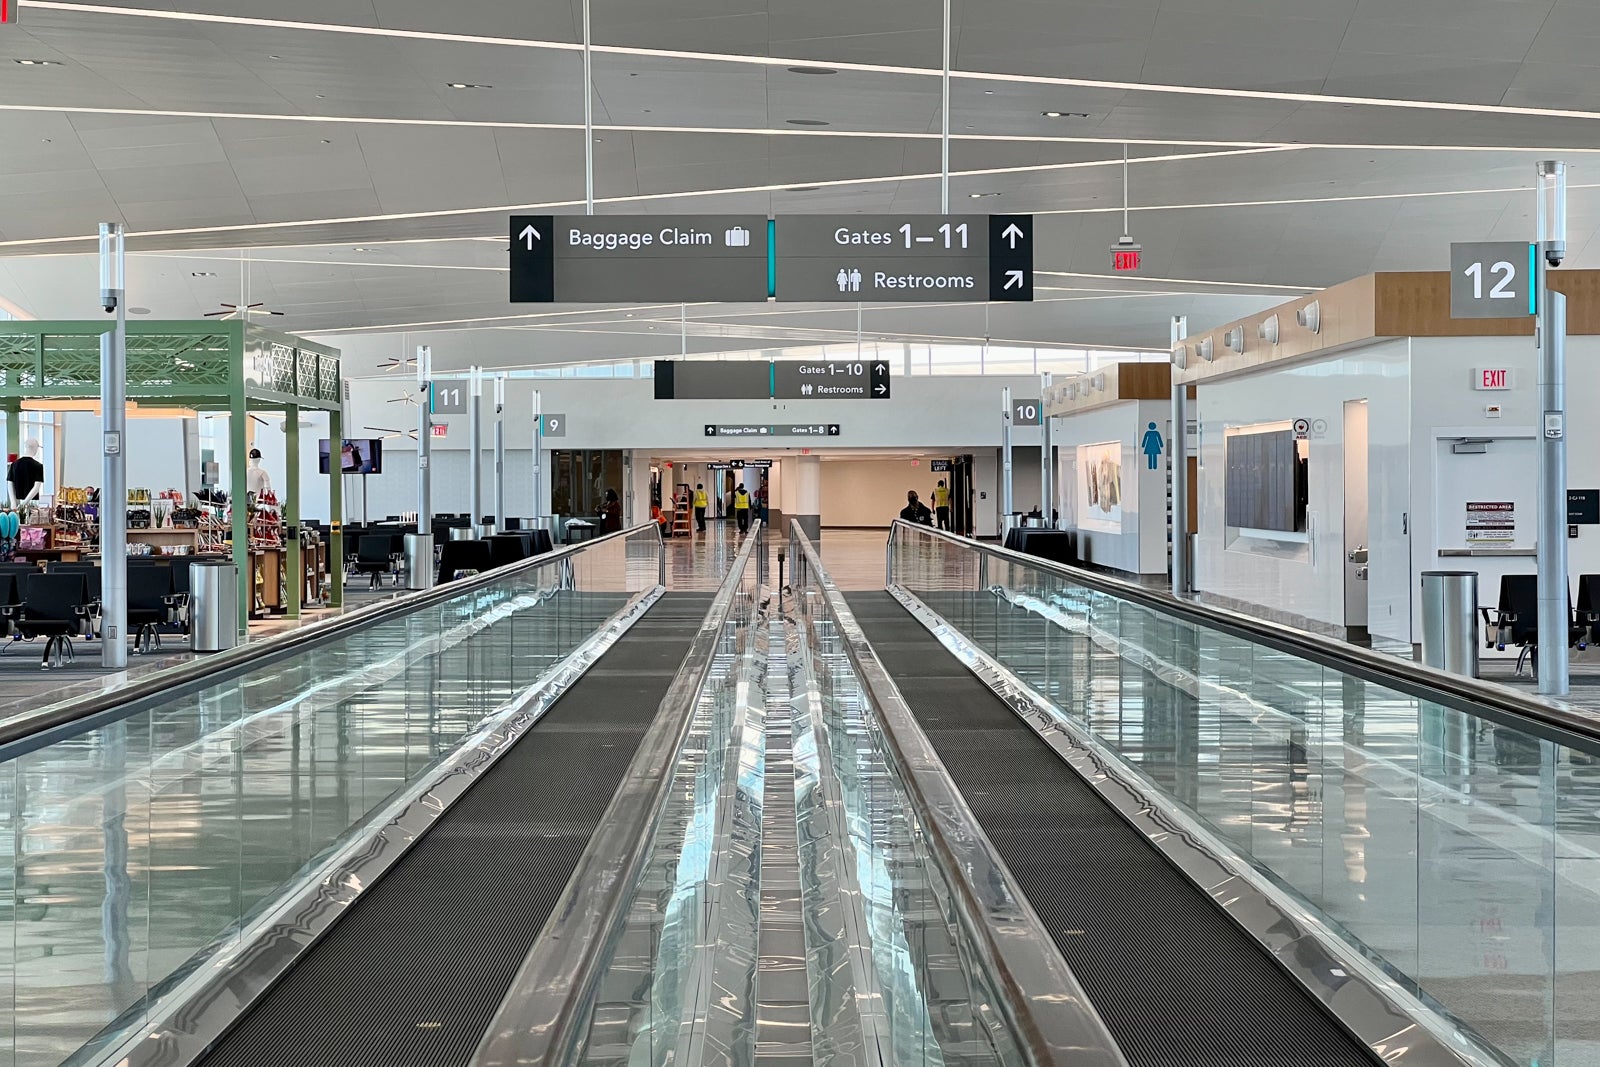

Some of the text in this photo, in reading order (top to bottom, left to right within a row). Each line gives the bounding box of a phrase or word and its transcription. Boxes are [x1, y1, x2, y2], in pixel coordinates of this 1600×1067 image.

[569, 228, 712, 250] Baggage Claim
[834, 228, 892, 245] Gates
[1115, 252, 1137, 270] EXIT
[874, 271, 975, 289] Restrooms
[1464, 261, 1516, 299] 12
[799, 365, 826, 374] Gates
[1483, 370, 1506, 387] EXIT
[440, 388, 459, 406] 11
[817, 385, 864, 394] Restrooms
[1016, 405, 1036, 420] 10
[549, 419, 559, 432] 9
